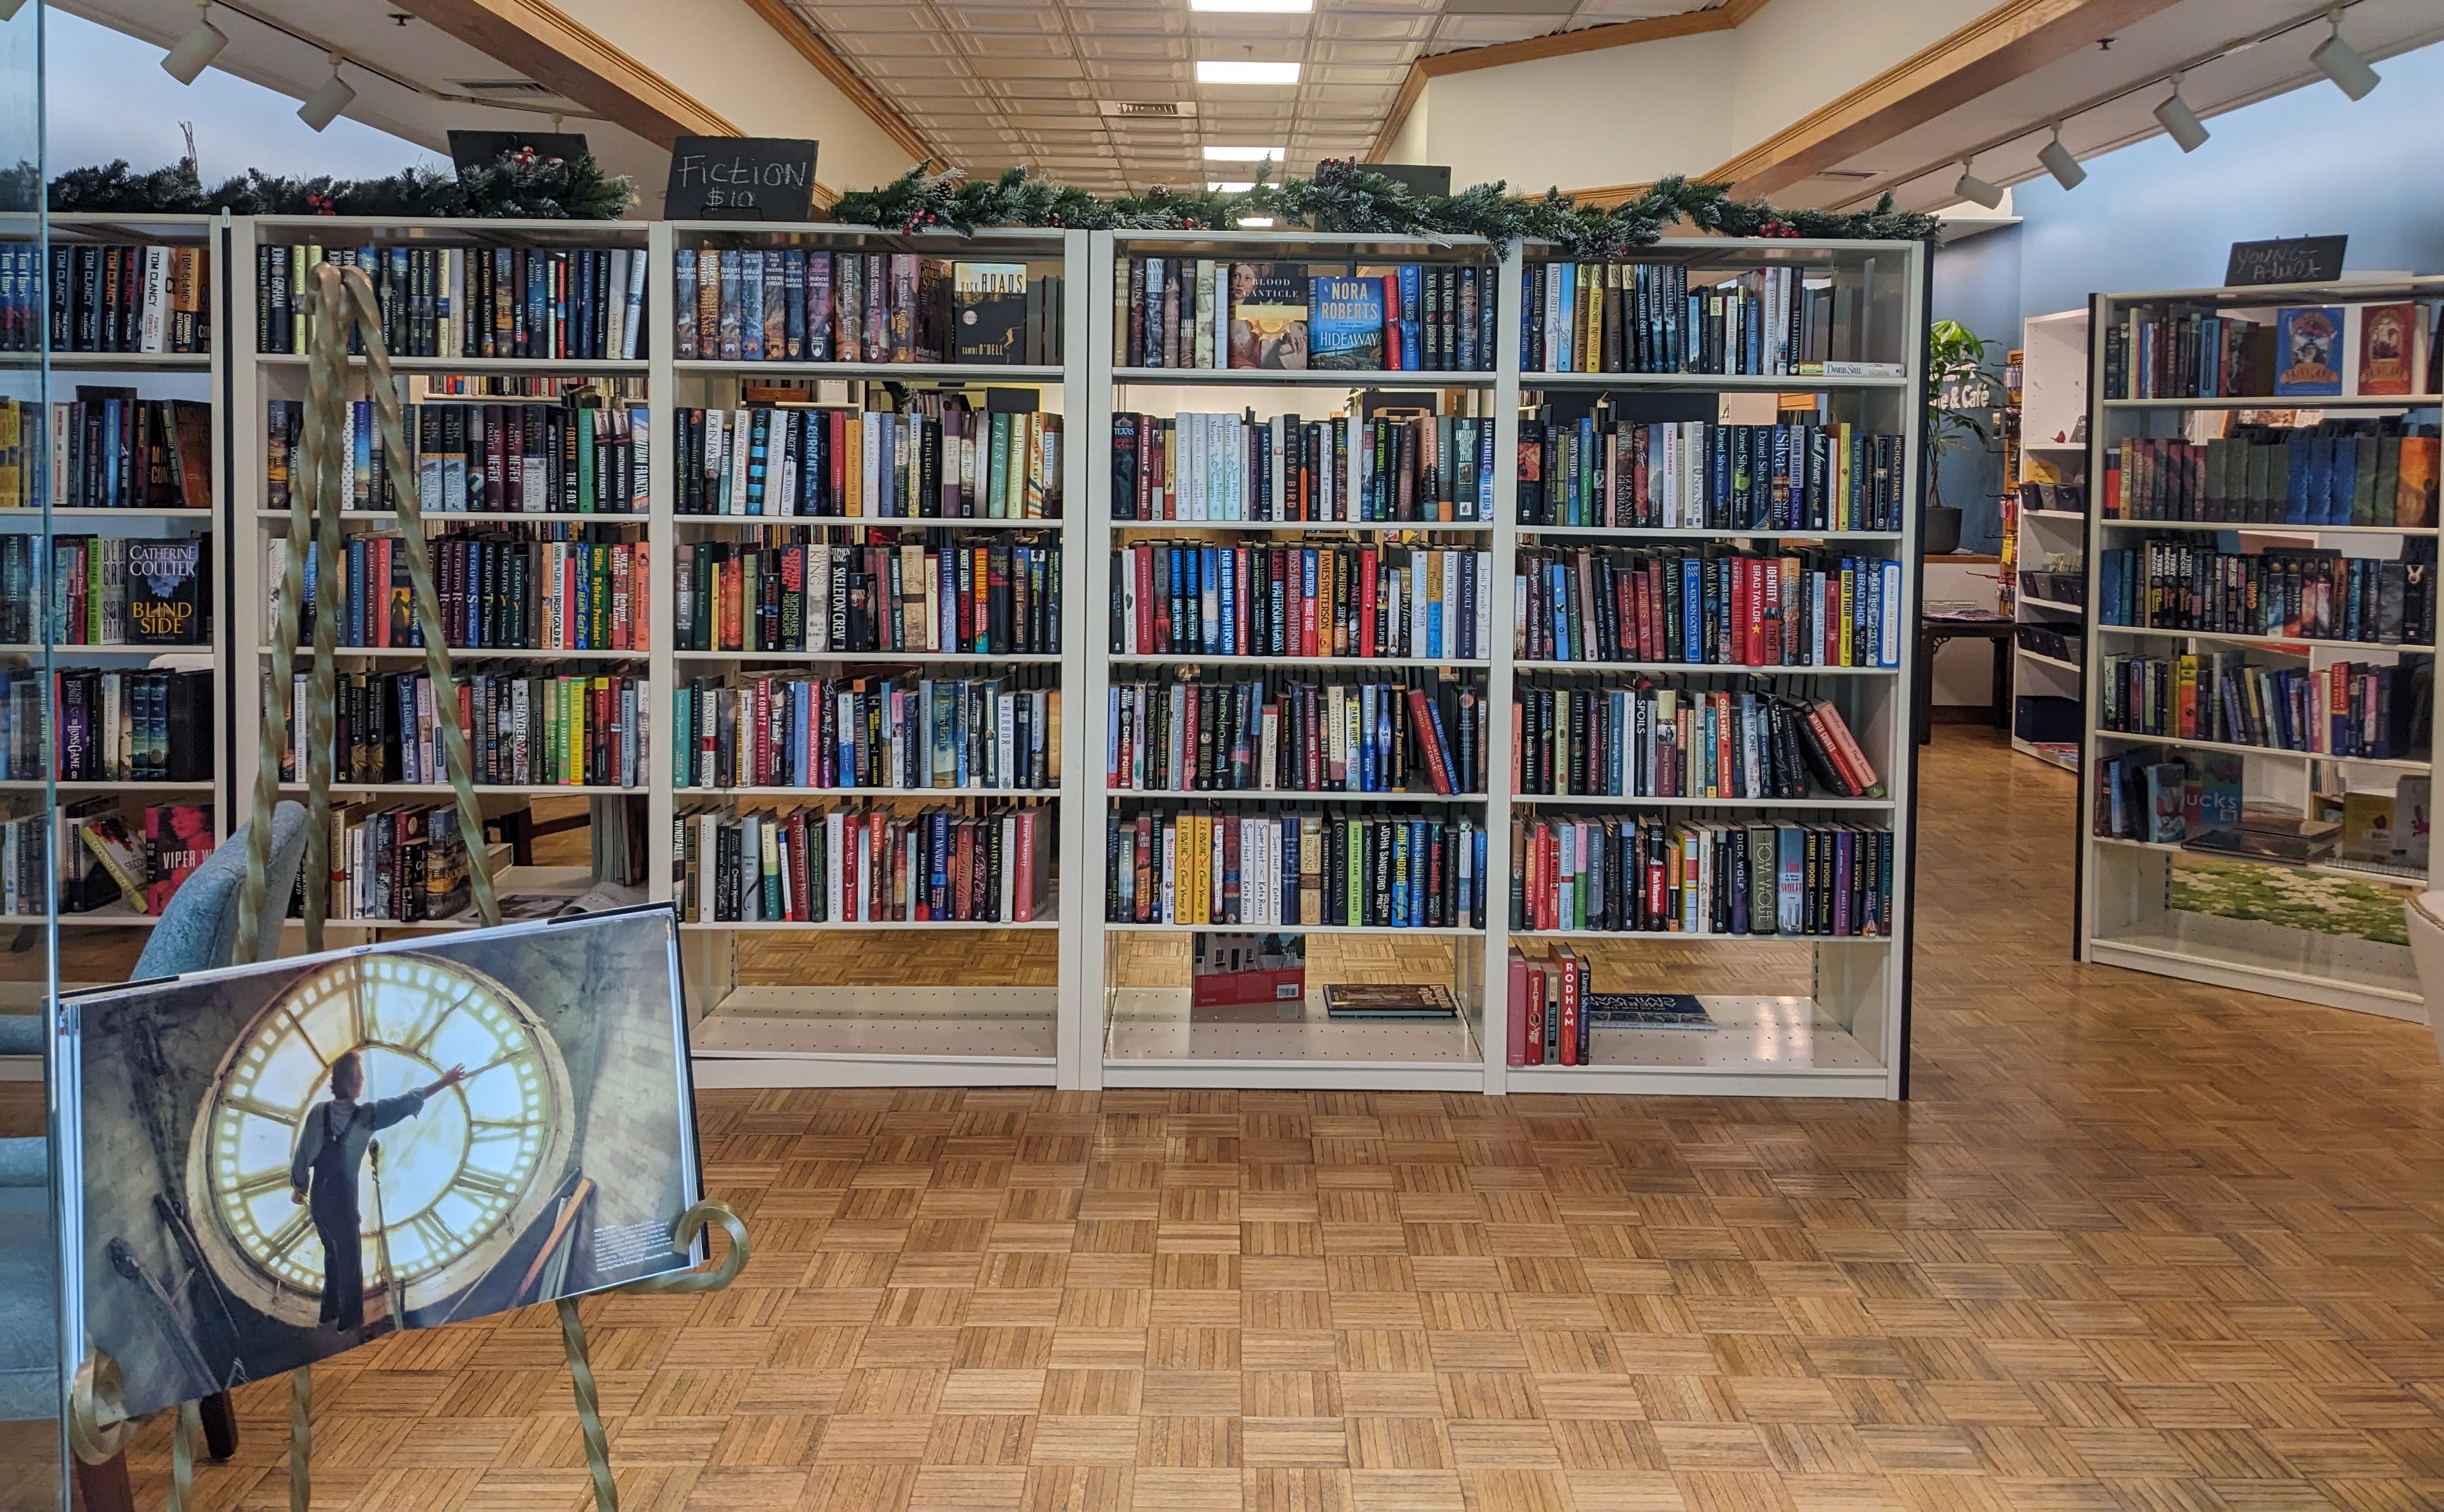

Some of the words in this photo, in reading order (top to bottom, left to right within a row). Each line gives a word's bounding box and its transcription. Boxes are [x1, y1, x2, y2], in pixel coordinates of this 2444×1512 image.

[108, 251, 117, 268] TOM
[150, 252, 159, 269] TOM
[182, 253, 190, 270] TOM
[271, 247, 284, 265] JOHN
[700, 254, 708, 285] Jordan
[708, 254, 717, 285] Robert
[1444, 273, 1453, 288] NORA
[107, 271, 116, 306] CLANCY
[149, 272, 159, 306] CLANCY
[181, 273, 190, 305] CLANCY
[272, 277, 284, 307] GRISHAM
[982, 273, 1023, 293] ROADS
[1134, 269, 1143, 298] VIOLIN
[1331, 283, 1368, 300] NORA
[1321, 302, 1378, 320] ROBERTS
[1444, 290, 1453, 311] ROBERTS
[1534, 298, 1542, 315] STEEL
[1320, 332, 1379, 346] HIDEAWAY
[1590, 327, 1599, 358] IMPOSSIBLE
[708, 414, 718, 440] JOHN
[1484, 421, 1492, 437] SEAN
[566, 427, 576, 459] FORSYTH
[706, 442, 717, 468] JAKES
[806, 426, 817, 472] CURRENT
[994, 421, 1004, 471] TRUST
[1012, 435, 1024, 454] Help
[1287, 427, 1297, 474] YELLOW
[1775, 433, 1789, 467] Silva
[566, 471, 576, 487] THE
[1792, 457, 1800, 487] SLAUGHTER
[567, 490, 576, 504] FOX
[1287, 481, 1296, 508] BIRD
[1483, 497, 1491, 510] DEAD
[129, 546, 195, 560] CATHERINE
[960, 549, 968, 569] ROBERT
[1222, 551, 1232, 567] FOUR
[130, 561, 195, 575] COULTER
[809, 551, 819, 585] KING
[1222, 569, 1232, 587] BLIND
[1321, 553, 1330, 580] JAMES
[1753, 565, 1761, 589] BRAD
[833, 567, 846, 611] SKELETON
[960, 570, 968, 591] LUDLUM
[1767, 566, 1777, 602] IDENTITY
[1222, 589, 1232, 605] MICE
[1321, 581, 1330, 629] PATTERSON
[1753, 591, 1761, 622] TAYLOR
[132, 602, 192, 618] BLIND
[1857, 600, 1865, 625] THOR
[140, 618, 183, 633] SIDE
[832, 614, 845, 640] CREW
[1222, 613, 1232, 651] PATTERSON
[516, 704, 525, 740] HAYDER
[1001, 706, 1010, 744] HARBOR
[1637, 700, 1645, 733] SPOILS
[1749, 721, 1755, 733] BY
[1349, 727, 1357, 750] HORSE
[68, 745, 81, 769] GAME
[2183, 792, 2237, 810] ucks
[674, 820, 683, 855] WINDFALL
[1257, 825, 1265, 844] Super
[1380, 826, 1390, 849] JOHN
[162, 850, 196, 869] VIPER
[1757, 841, 1773, 874] TOM
[1377, 851, 1388, 890] SANDFORD
[1757, 879, 1773, 921] WOLFE
[1565, 963, 1574, 1026] RODHAM
